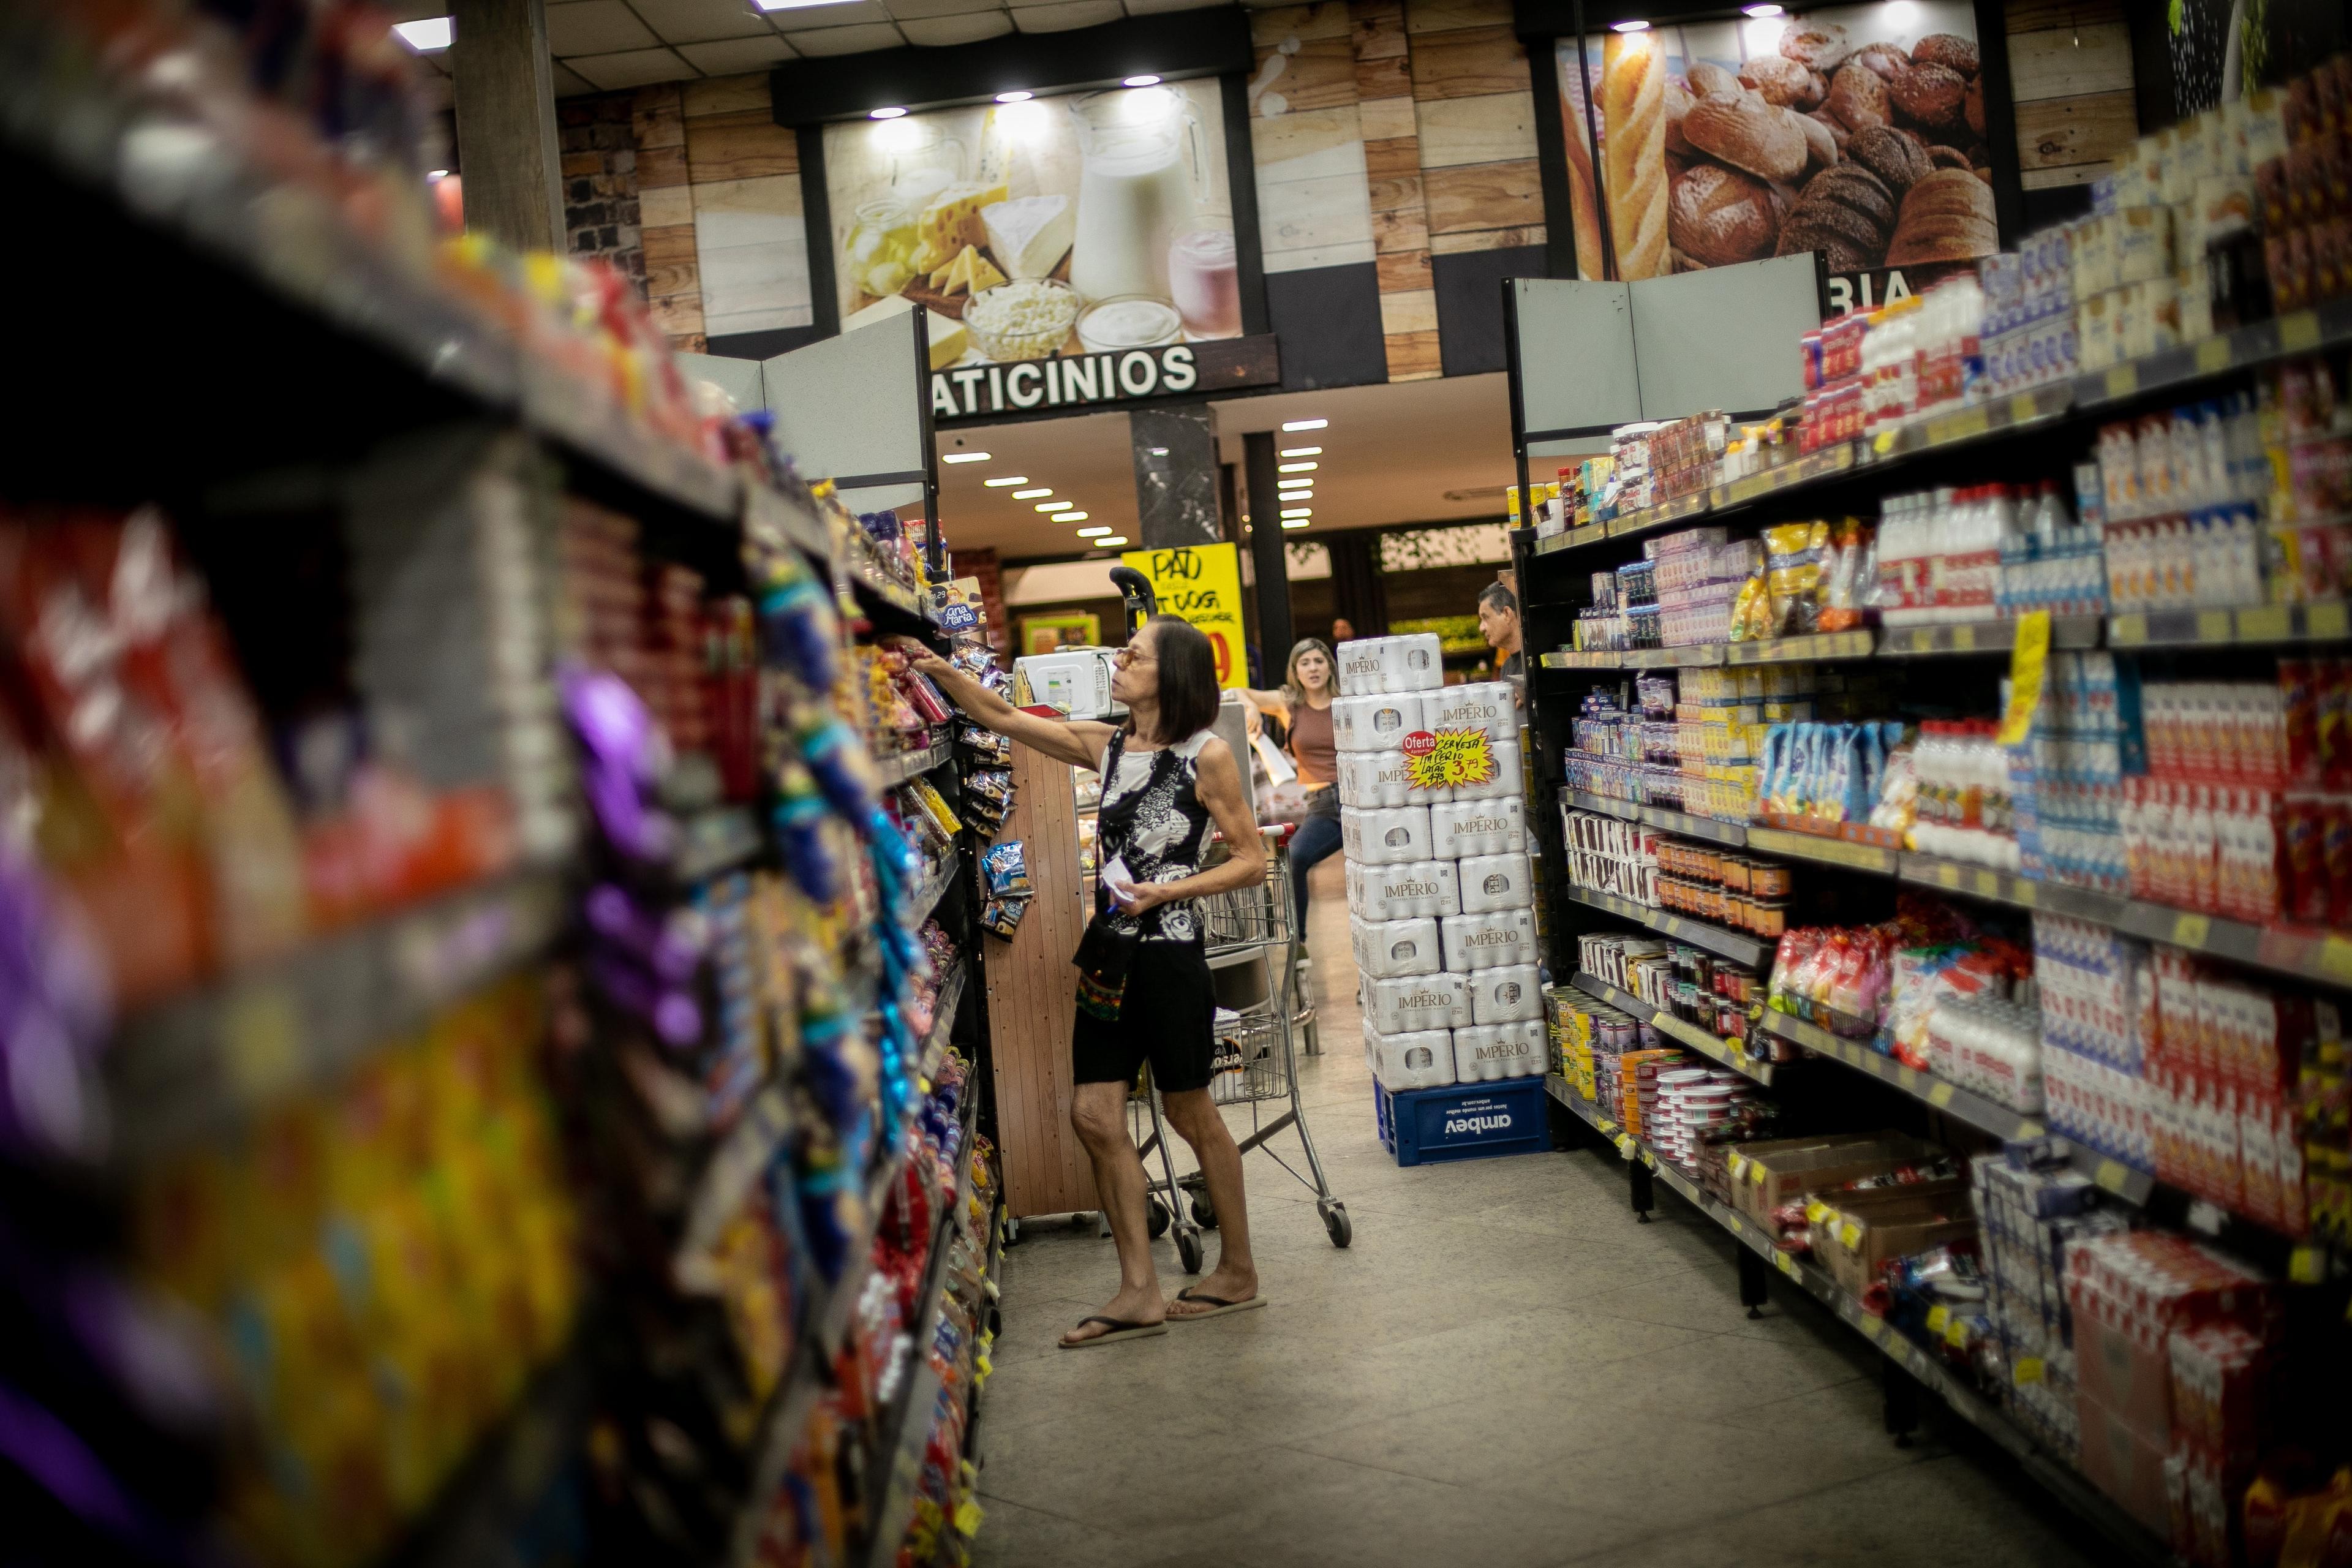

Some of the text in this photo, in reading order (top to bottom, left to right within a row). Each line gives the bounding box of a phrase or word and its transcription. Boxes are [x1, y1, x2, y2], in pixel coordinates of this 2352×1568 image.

[932, 345, 1197, 417] ATICINIOS
[944, 612, 974, 626] Maria
[1404, 736, 1436, 750] Oferta
[1434, 734, 1480, 752] CERVEJA
[1419, 750, 1464, 766] IMPERIO
[1445, 1114, 1512, 1134] ambev
